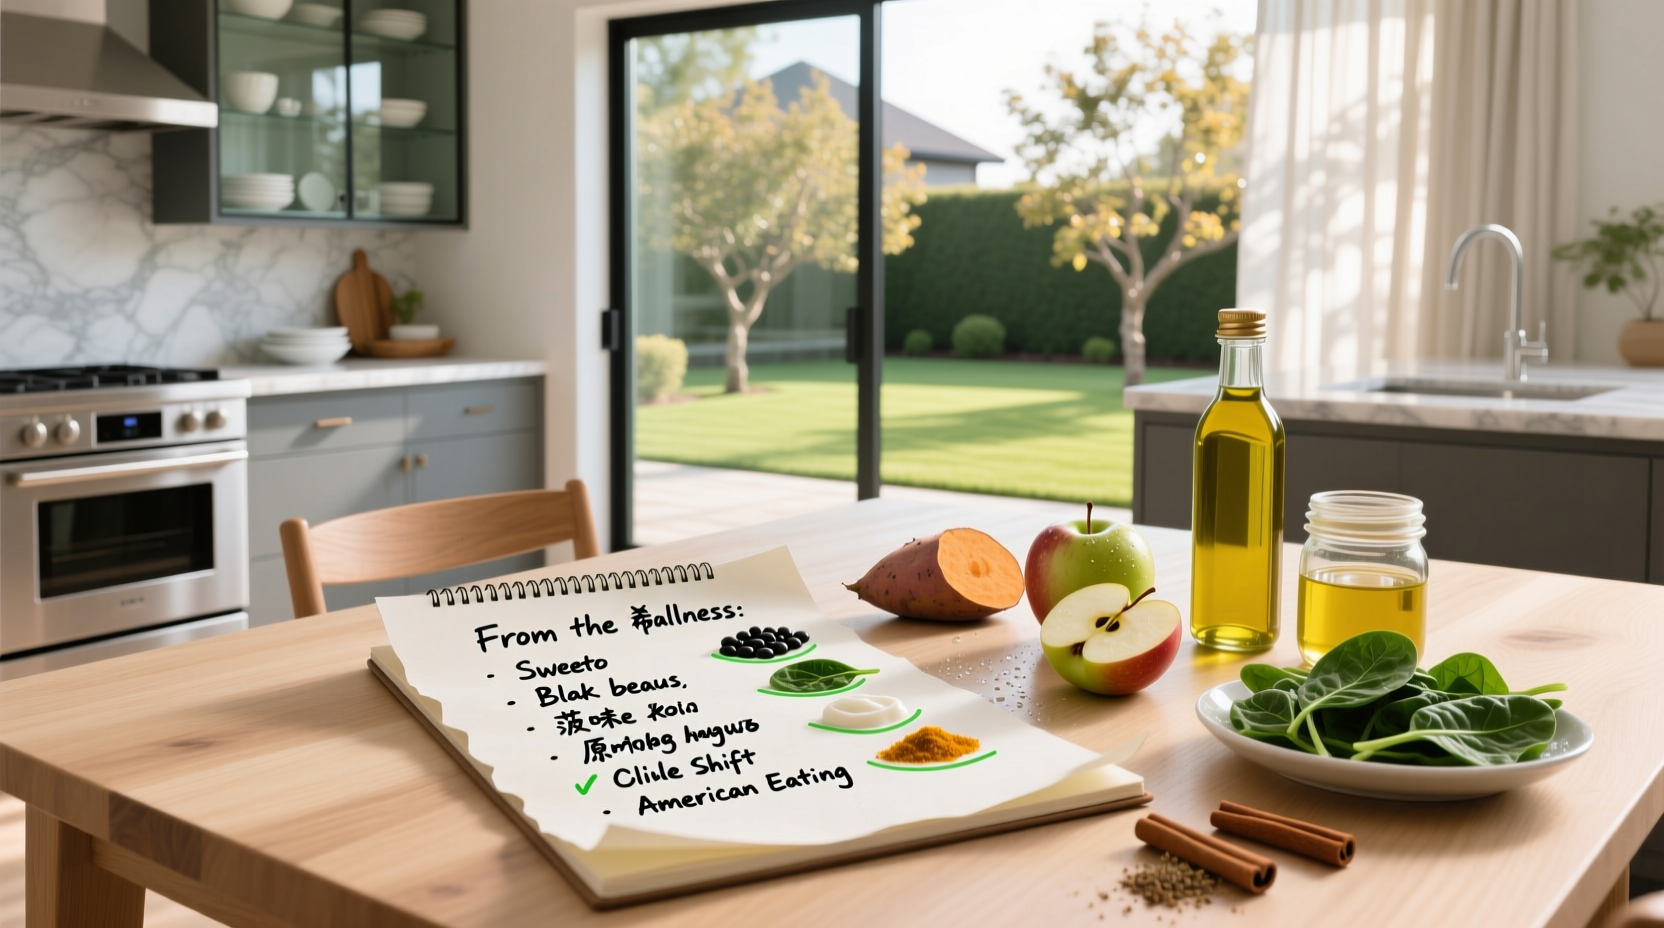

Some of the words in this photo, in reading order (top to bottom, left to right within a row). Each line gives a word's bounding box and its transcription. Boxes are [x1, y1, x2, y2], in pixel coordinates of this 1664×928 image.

[474, 623, 558, 653] From
[569, 613, 619, 638] the
[515, 655, 608, 681] Sweeto
[534, 682, 601, 708] Blak
[690, 748, 756, 775] Shift
[637, 784, 760, 816] American
[765, 766, 854, 792] Eating
